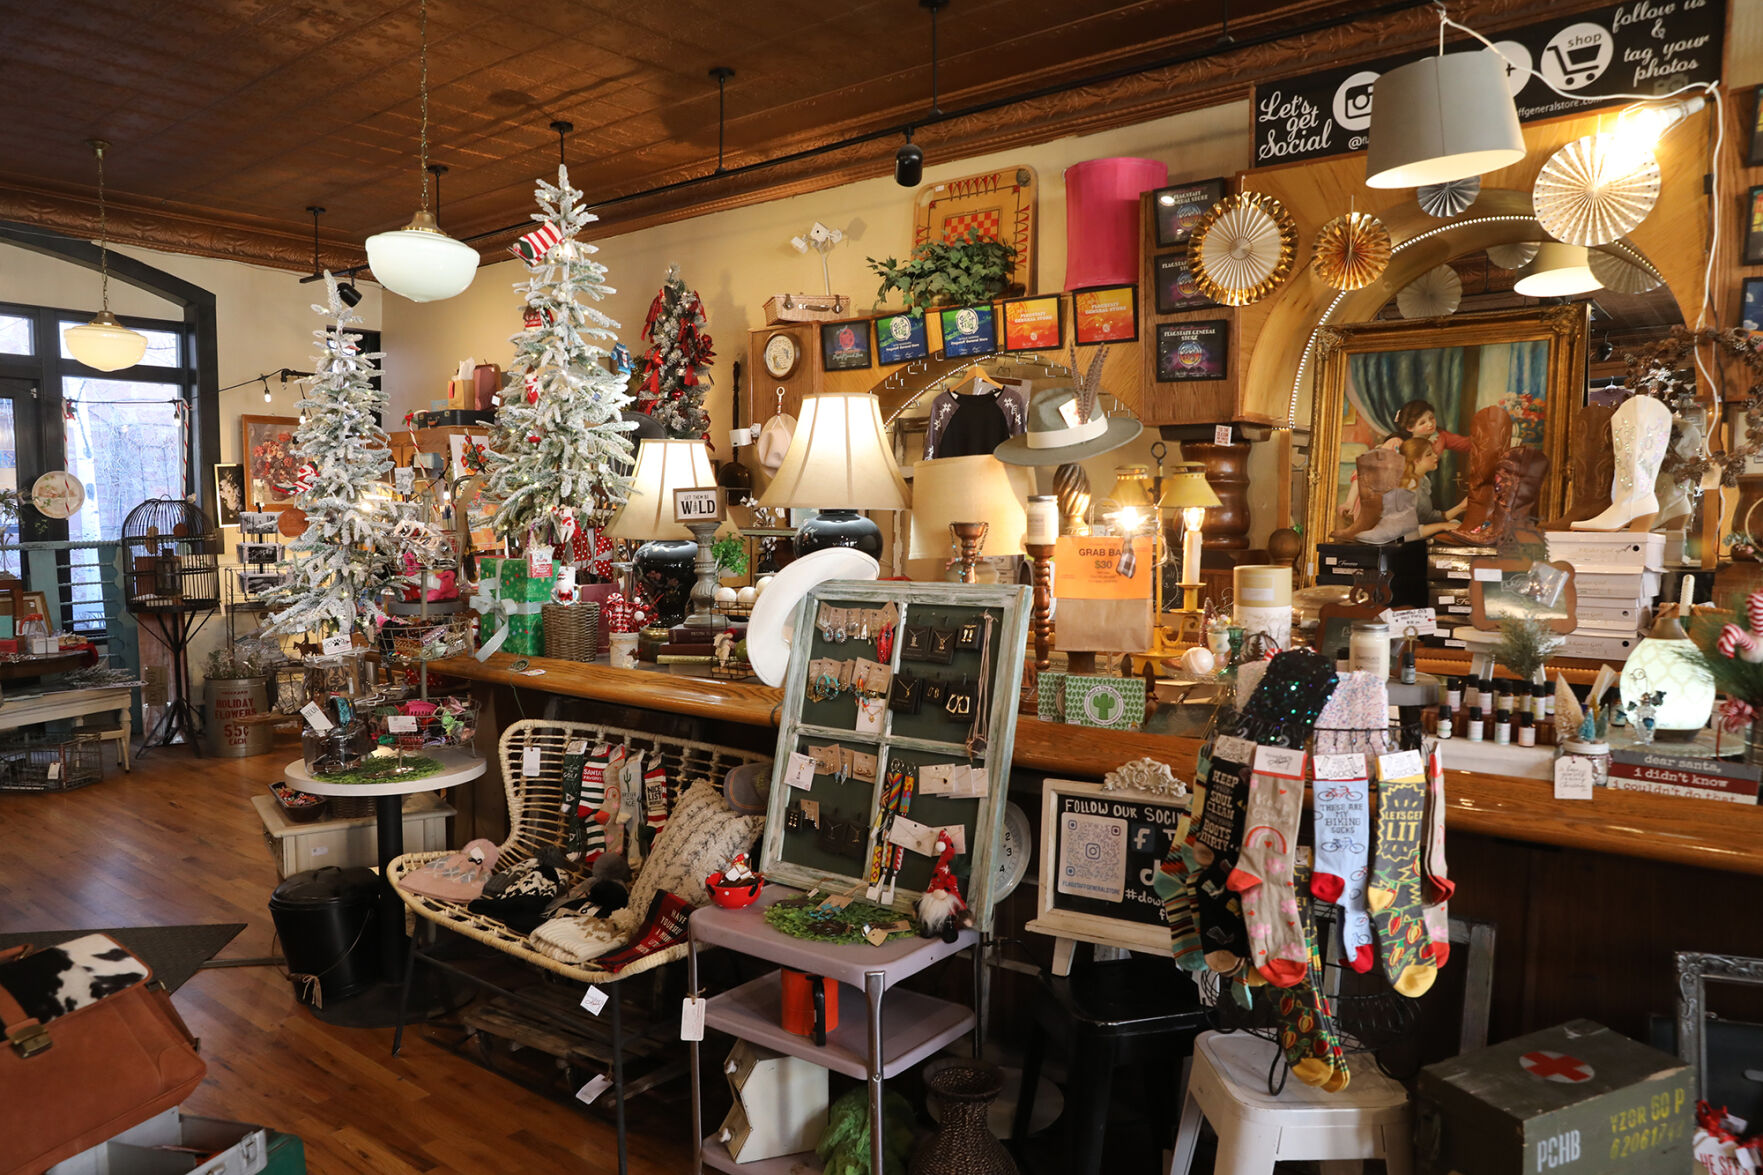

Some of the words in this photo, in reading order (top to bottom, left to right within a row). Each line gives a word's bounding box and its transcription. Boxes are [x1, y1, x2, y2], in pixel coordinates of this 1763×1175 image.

[1612, 0, 1676, 33] follow
[1651, 18, 1666, 39] &
[1568, 32, 1602, 48] shop
[1624, 47, 1653, 65] tag
[1663, 35, 1709, 57] your
[1633, 57, 1699, 88] photos
[1259, 91, 1312, 122] Let's
[1286, 105, 1319, 142] get
[1259, 119, 1332, 160] Social
[1079, 548, 1106, 556] GRAB
[1109, 548, 1122, 556] BA
[1095, 560, 1112, 569] $30
[216, 698, 254, 708] HOLIDAY
[215, 708, 257, 720] FLOWERS
[1644, 755, 1676, 768] dear
[1679, 760, 1722, 773] santa,
[1212, 770, 1239, 788] KEEP
[1634, 768, 1642, 777] i
[1645, 769, 1688, 783] didn't
[1692, 773, 1729, 788] know
[1613, 780, 1620, 788] i
[1624, 781, 1680, 796] couldn't
[1684, 790, 1700, 799] do
[1209, 790, 1233, 808] SOUL
[1319, 803, 1345, 811] THESE
[1065, 800, 1108, 814] FOLLOW
[1113, 806, 1138, 818] OUR
[1206, 801, 1235, 820] CLEAN
[1407, 811, 1424, 820] GET
[1204, 818, 1232, 840] BOOTS
[1325, 818, 1361, 826] BIKING
[1005, 832, 1011, 841] 2
[1387, 822, 1419, 841] LIT
[1200, 831, 1229, 852] DIRTY
[1006, 848, 1012, 856] 3
[1000, 864, 1005, 872] 4
[671, 909, 687, 924] HAVE
[1651, 1092, 1670, 1120] 60
[1674, 1088, 1685, 1114] P
[1537, 1130, 1580, 1172] PCHB
